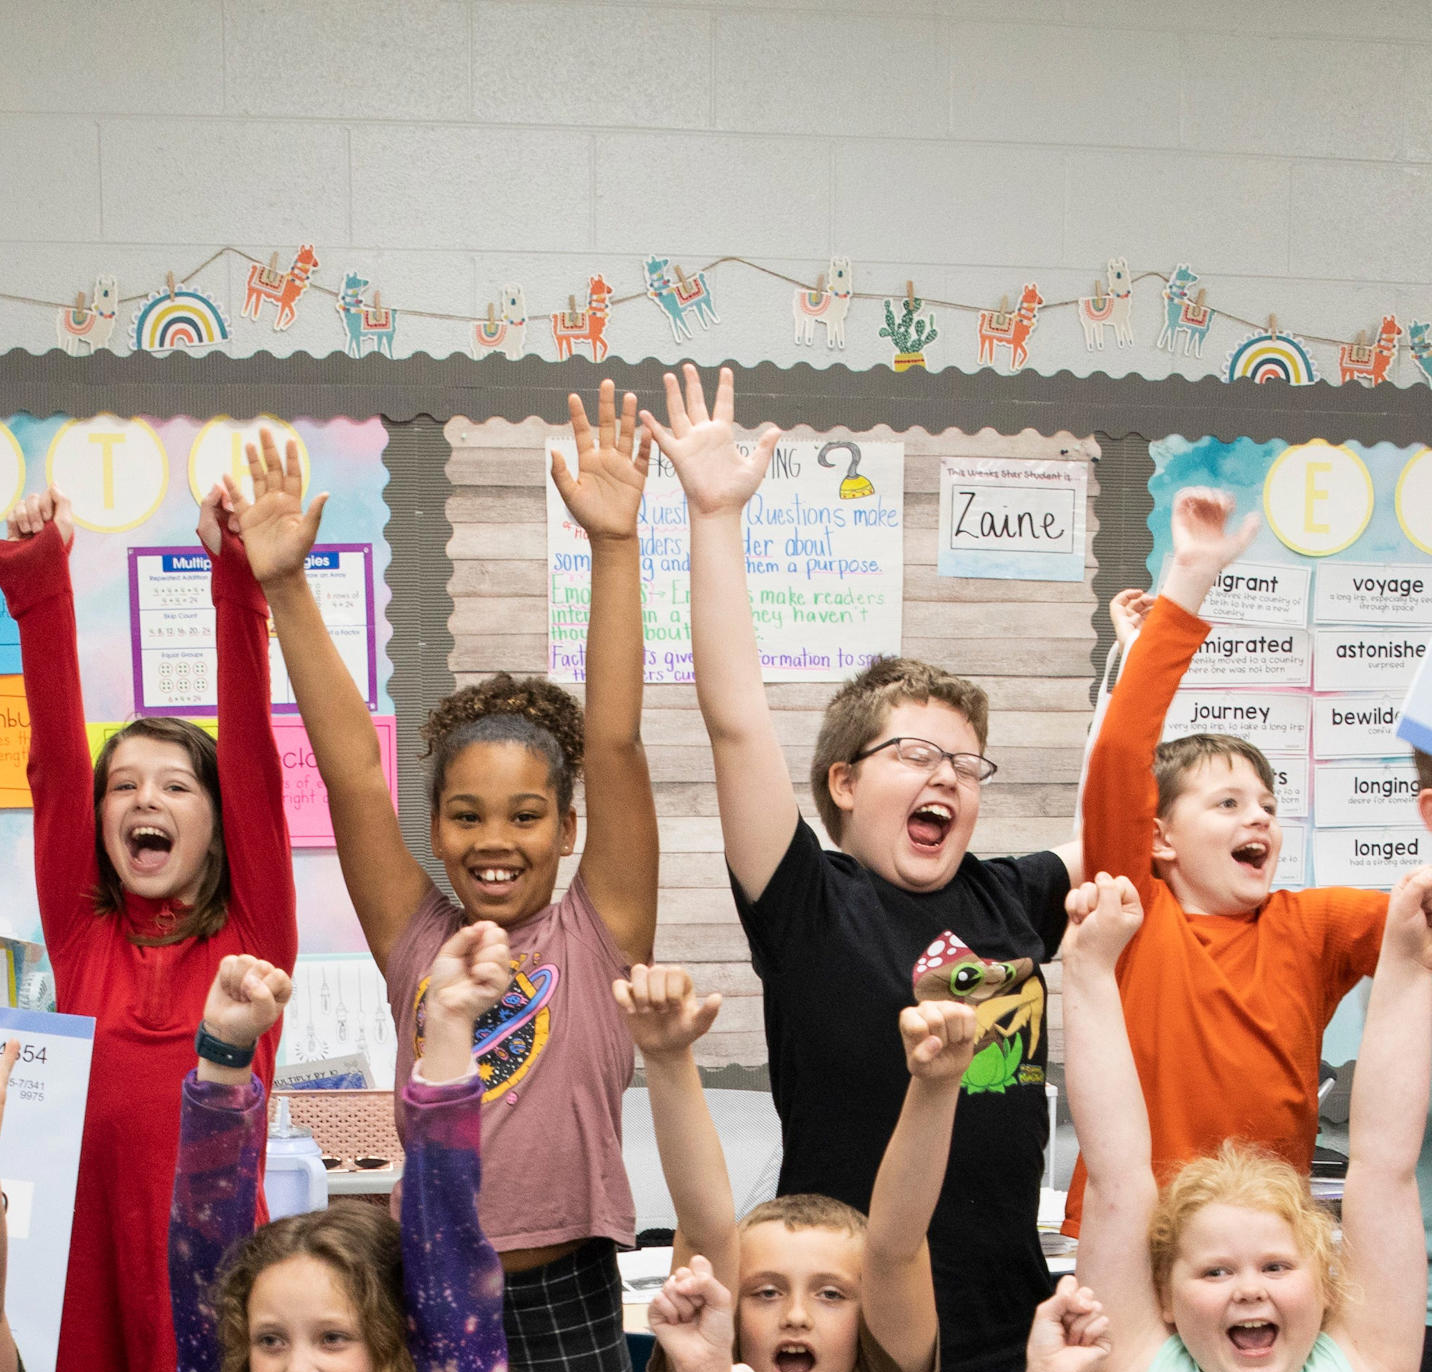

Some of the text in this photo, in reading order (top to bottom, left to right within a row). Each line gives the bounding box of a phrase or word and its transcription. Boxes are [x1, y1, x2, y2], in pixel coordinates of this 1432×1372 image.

[747, 493, 899, 528] Questions make
[955, 492, 1066, 540] Zaine
[785, 525, 834, 557] about
[746, 556, 779, 573] hem
[788, 562, 797, 573] a
[807, 559, 883, 580] purpose.
[1213, 571, 1278, 593] igrant
[1353, 578, 1424, 597] voyage
[760, 586, 885, 606] make readers
[793, 606, 869, 623] haven't
[644, 623, 691, 641] bout
[1198, 636, 1293, 657] migrated
[1336, 640, 1426, 658] astonishe
[756, 648, 830, 667] ormation
[838, 648, 854, 667] to
[1218, 655, 1247, 665] moved
[1270, 656, 1304, 667] country
[1368, 661, 1405, 670] surprised
[1190, 702, 1270, 723] journey
[1332, 707, 1399, 725] bewild
[1354, 777, 1420, 797] longing
[1355, 838, 1418, 860] longed
[19, 1091, 45, 1102] 9975
